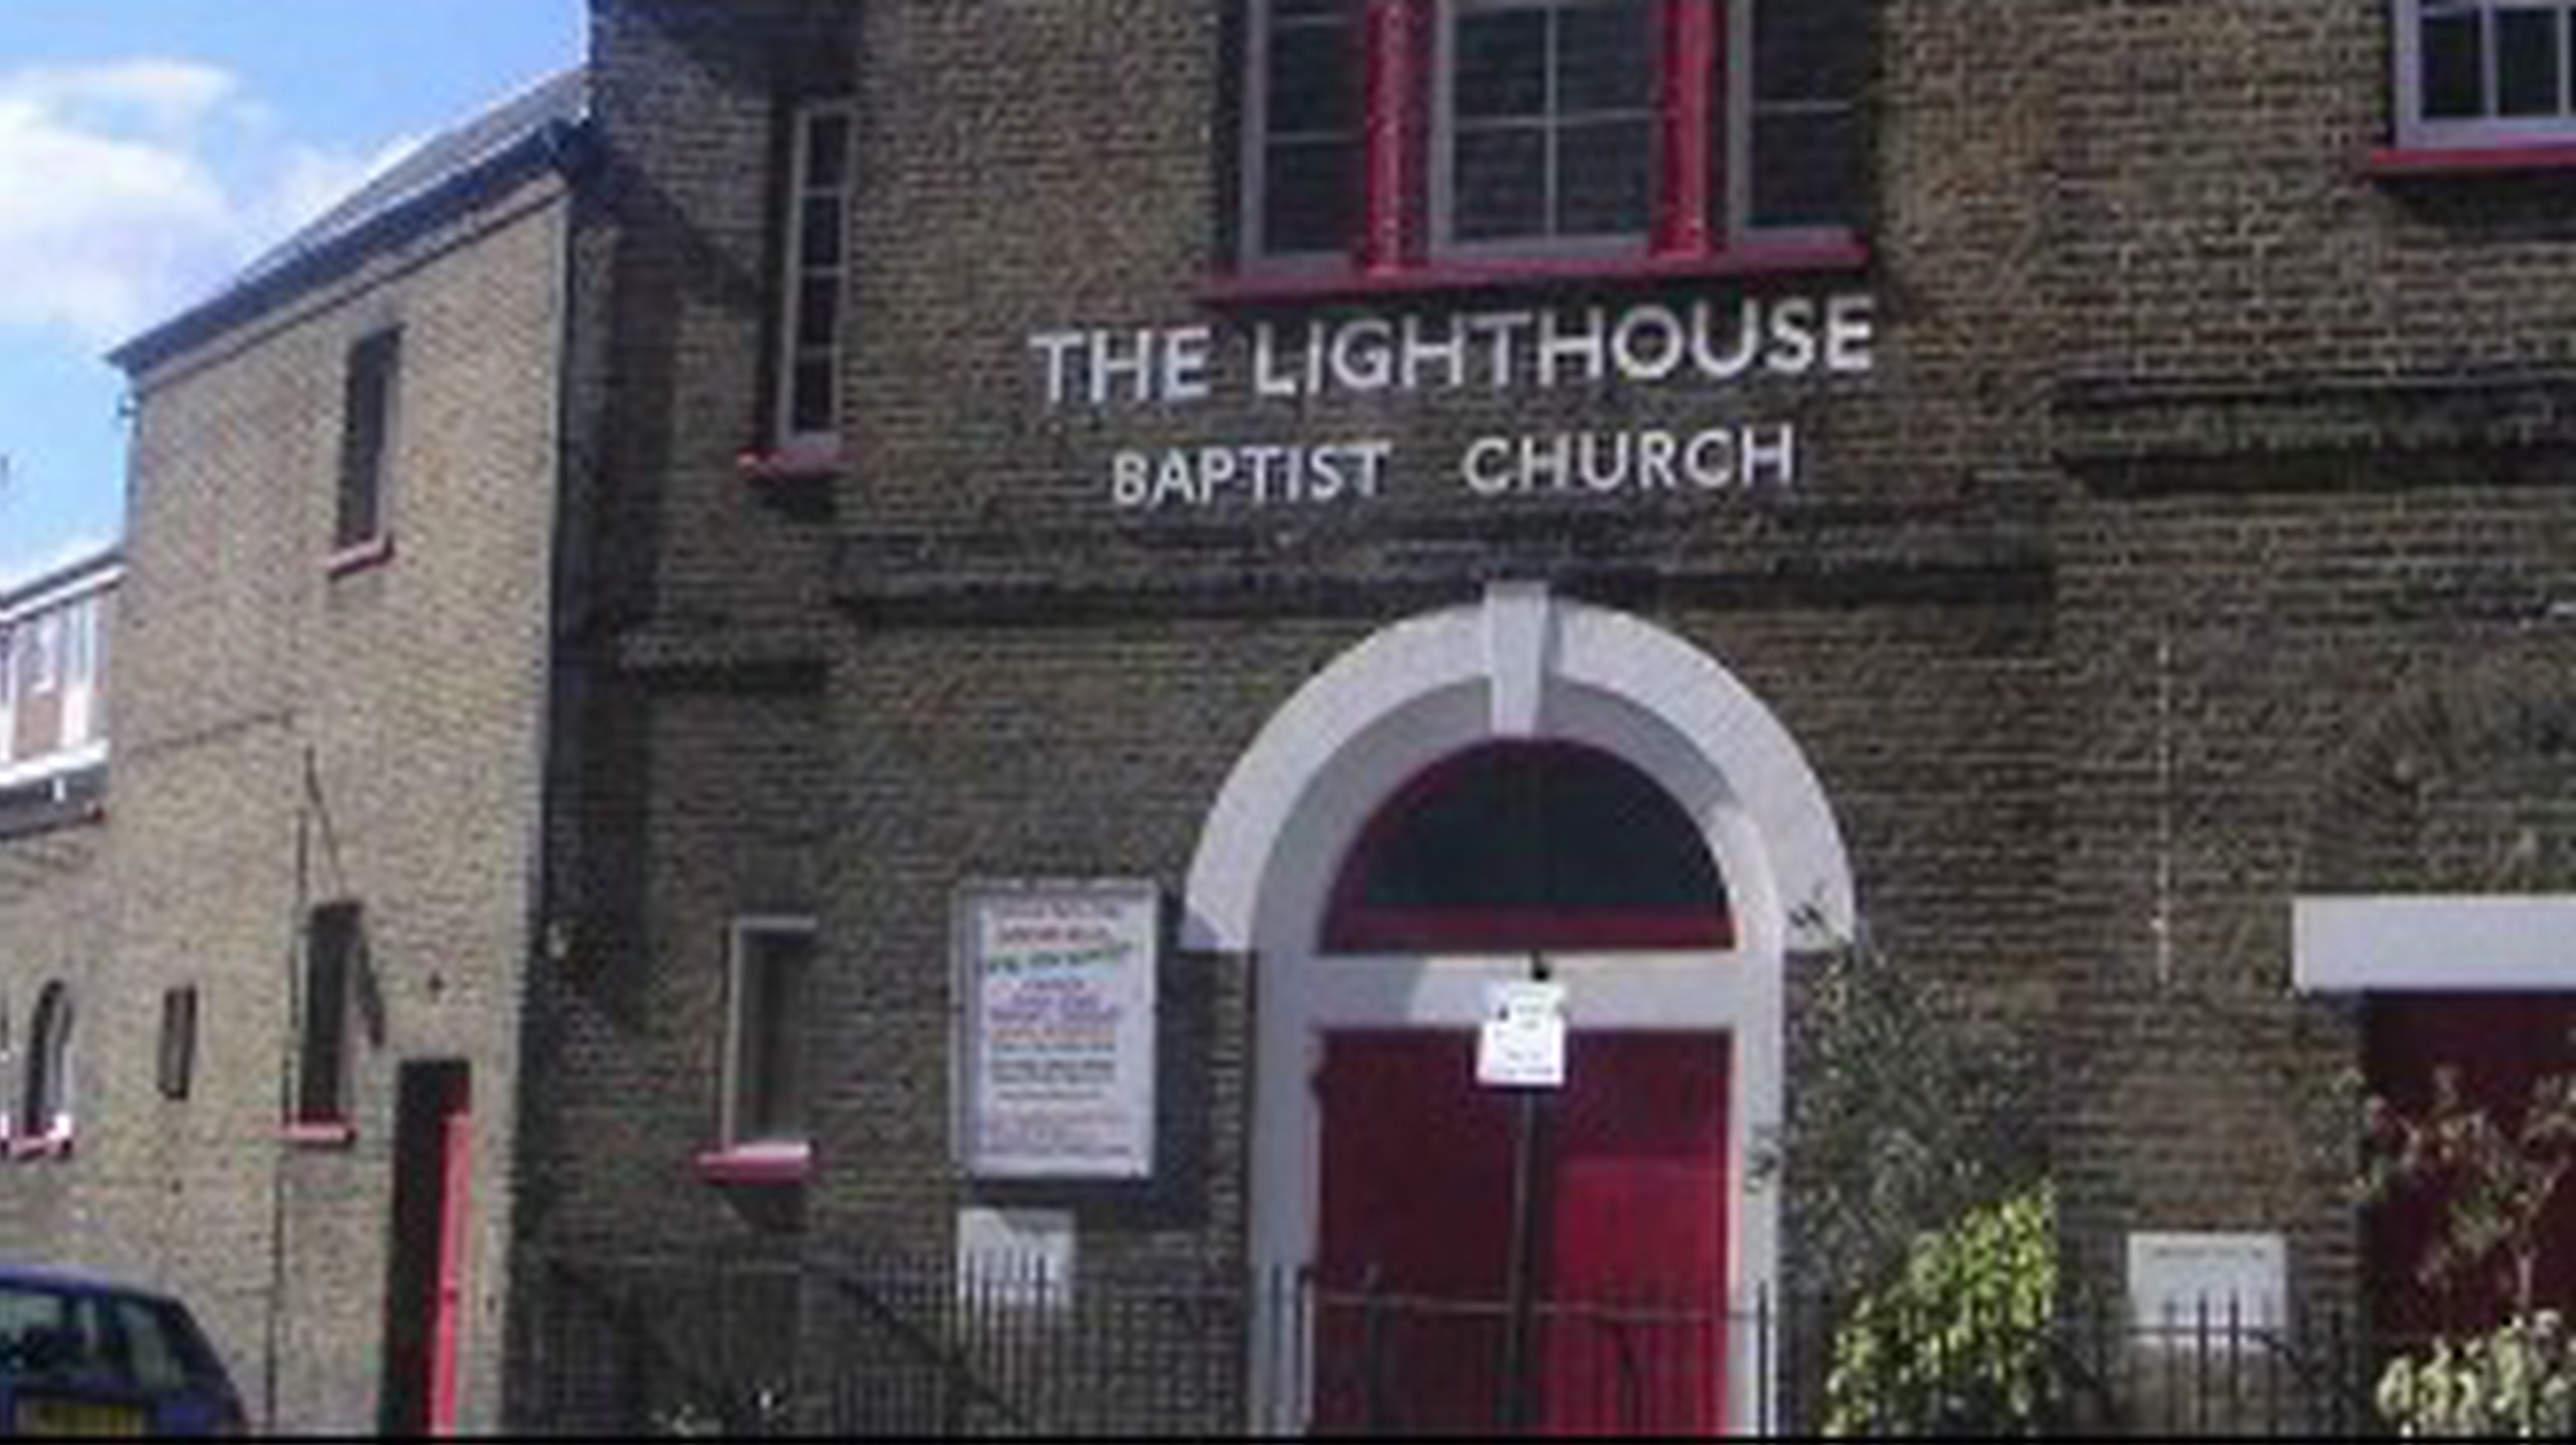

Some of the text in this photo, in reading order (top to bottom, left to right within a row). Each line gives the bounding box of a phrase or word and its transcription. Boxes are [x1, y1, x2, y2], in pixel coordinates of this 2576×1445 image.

[1029, 295, 1876, 405] THE LIGHTHOUSE
[1112, 423, 1795, 507] BAPTIST CHURCH
